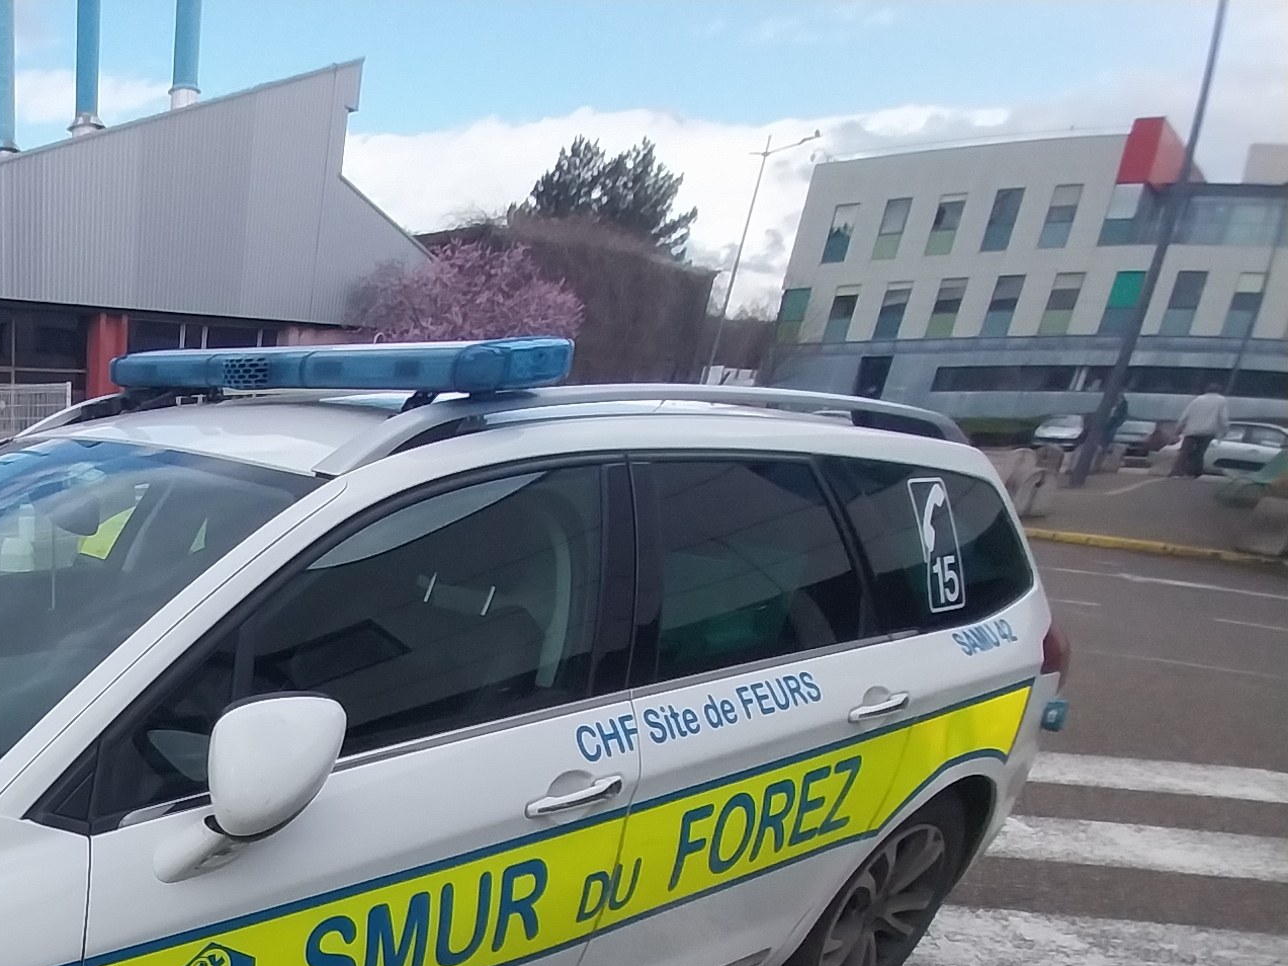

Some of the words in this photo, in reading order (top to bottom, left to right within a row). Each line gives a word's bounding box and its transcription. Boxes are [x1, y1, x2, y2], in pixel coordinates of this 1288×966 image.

[932, 555, 959, 604] 15
[952, 623, 1000, 656] SAMU
[994, 619, 1018, 642] 42
[576, 714, 639, 762] CHF
[644, 707, 701, 745] Site
[704, 694, 737, 729] de
[737, 672, 822, 720] FEURS
[576, 858, 642, 923] DU
[668, 755, 862, 892] FOREZ
